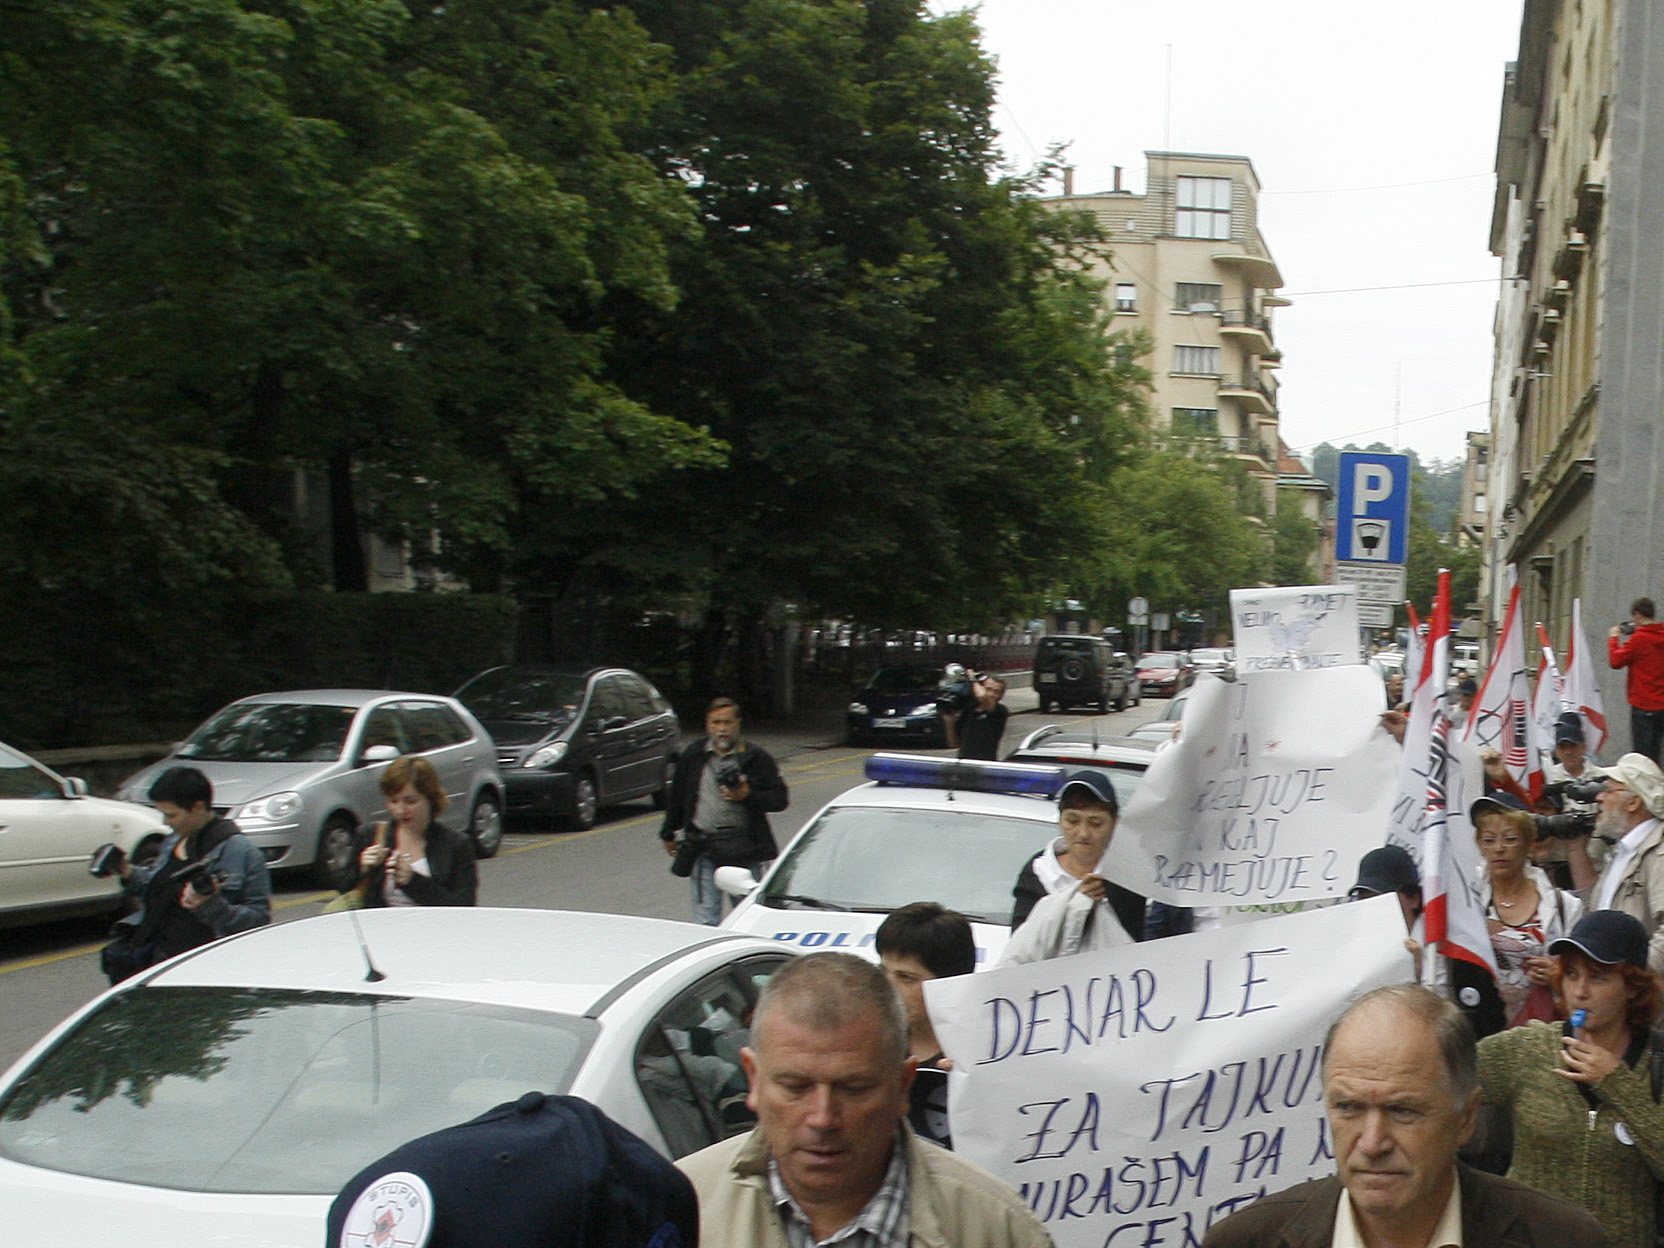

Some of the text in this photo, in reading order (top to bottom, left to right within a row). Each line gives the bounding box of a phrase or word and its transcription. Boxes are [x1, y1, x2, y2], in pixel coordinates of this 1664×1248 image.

[1353, 463, 1393, 515] P
[1220, 818, 1280, 859] KAJ
[975, 947, 1290, 1066] DENAR LE
[1014, 1045, 1322, 1164] ZA TAJKU
[1231, 1126, 1284, 1184] PA
